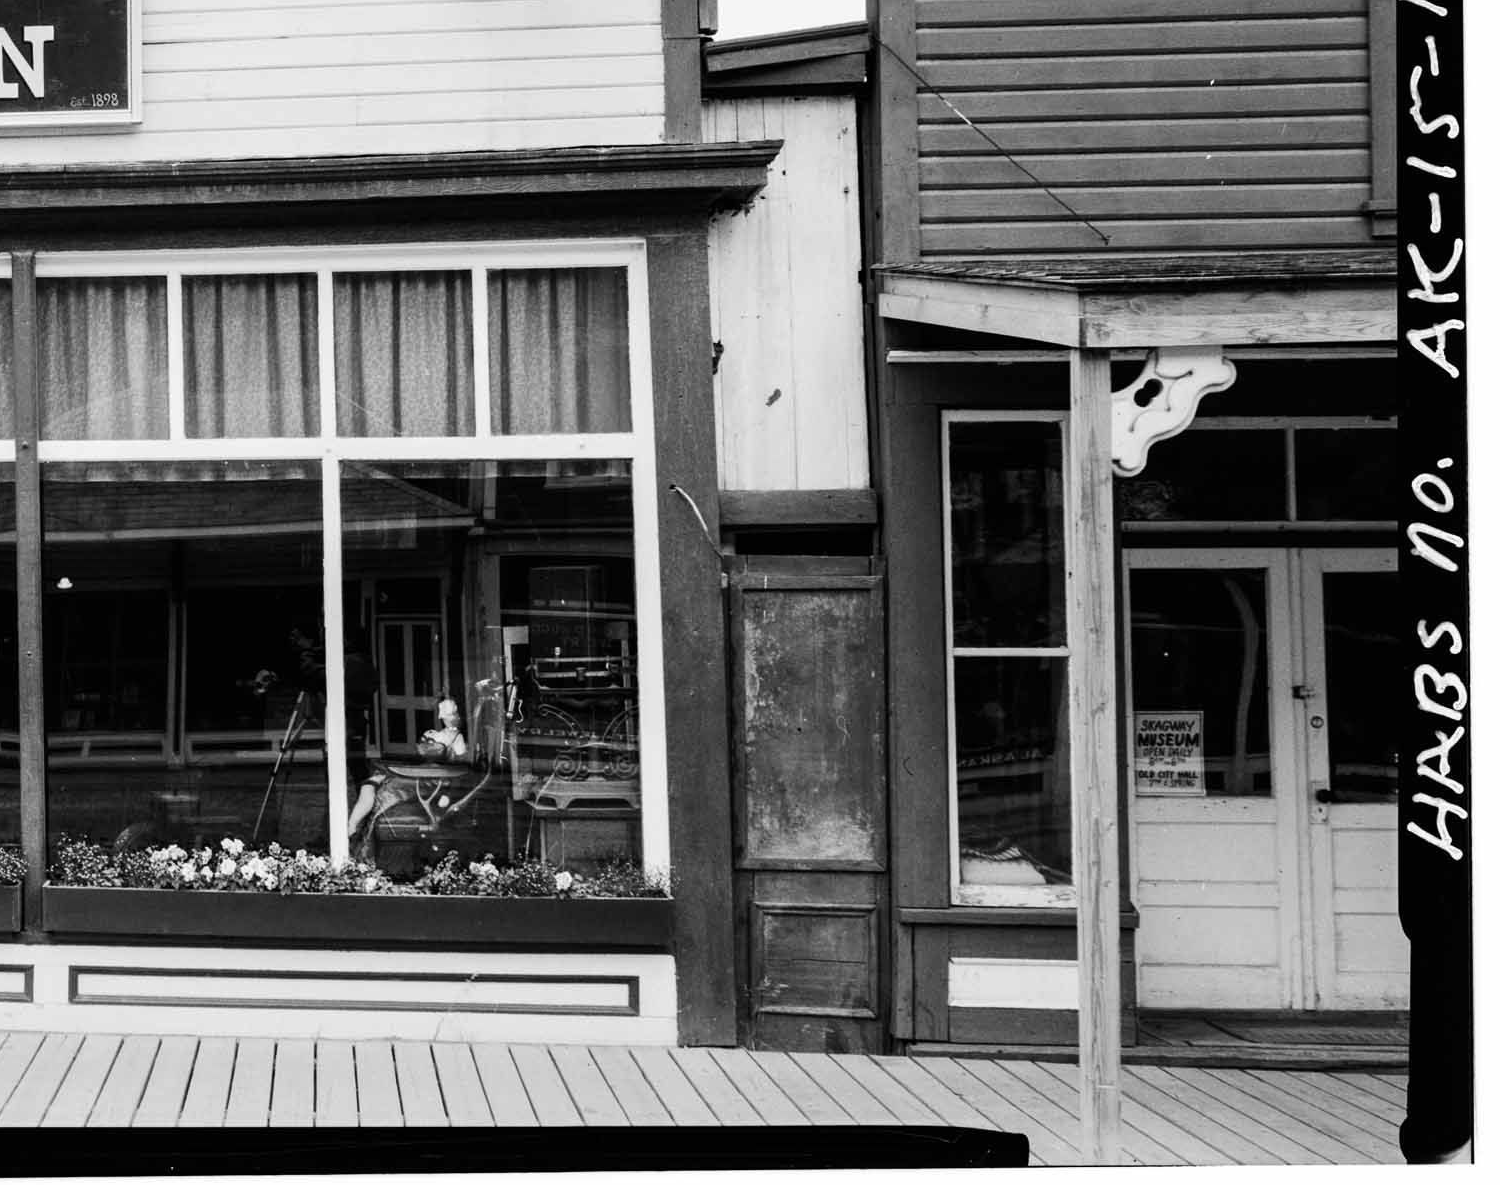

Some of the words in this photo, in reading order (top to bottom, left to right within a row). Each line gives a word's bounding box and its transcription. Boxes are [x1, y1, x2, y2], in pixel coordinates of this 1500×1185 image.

[91, 92, 119, 107] 1898
[1140, 719, 1195, 732] SKAGWAY
[1138, 733, 1199, 747] MUSEUM
[1143, 747, 1164, 757] OPEN
[1168, 747, 1194, 758] DAILY
